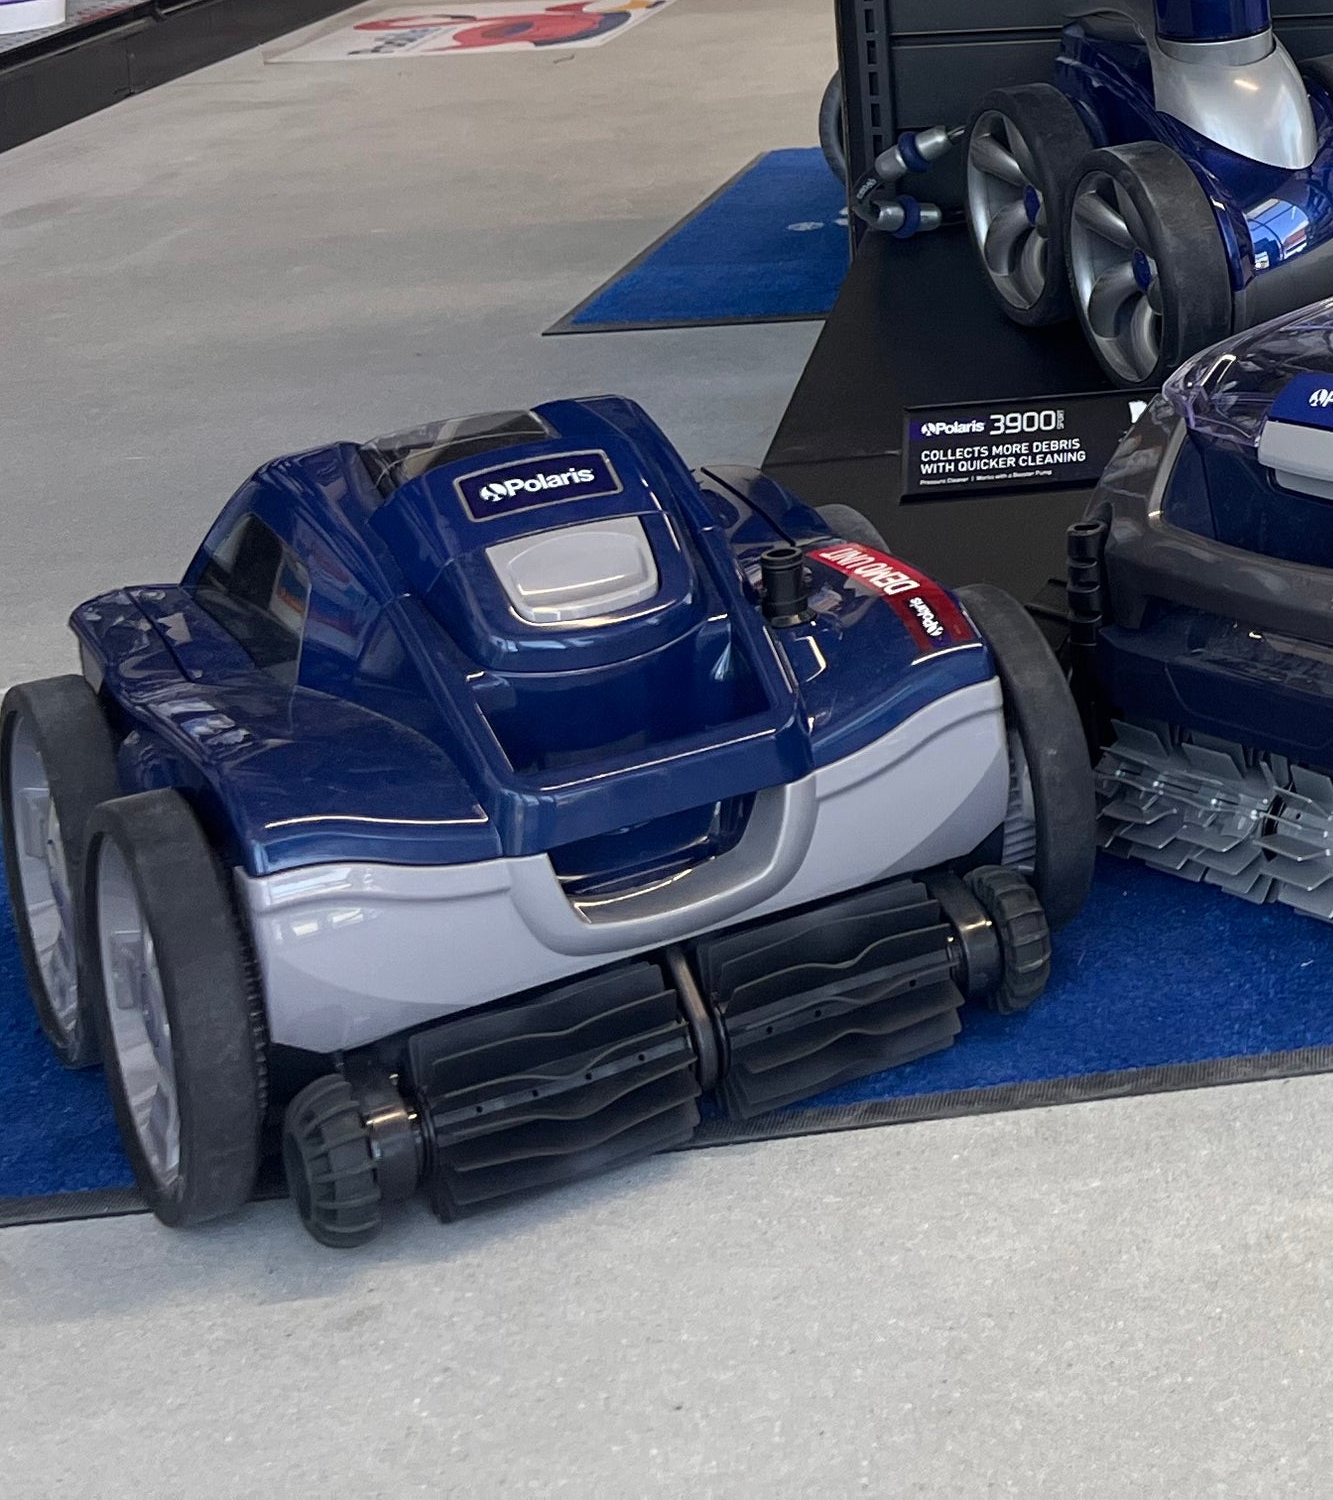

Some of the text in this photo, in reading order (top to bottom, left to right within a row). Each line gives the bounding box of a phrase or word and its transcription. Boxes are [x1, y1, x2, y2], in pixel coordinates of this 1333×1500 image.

[934, 419, 985, 436] Polaris
[989, 409, 1056, 436] 3900
[919, 450, 1087, 475] WITH QUICKER CLEANING
[920, 438, 1081, 462] COLLECTS MORE DEBRIS
[503, 467, 596, 498] Polaris
